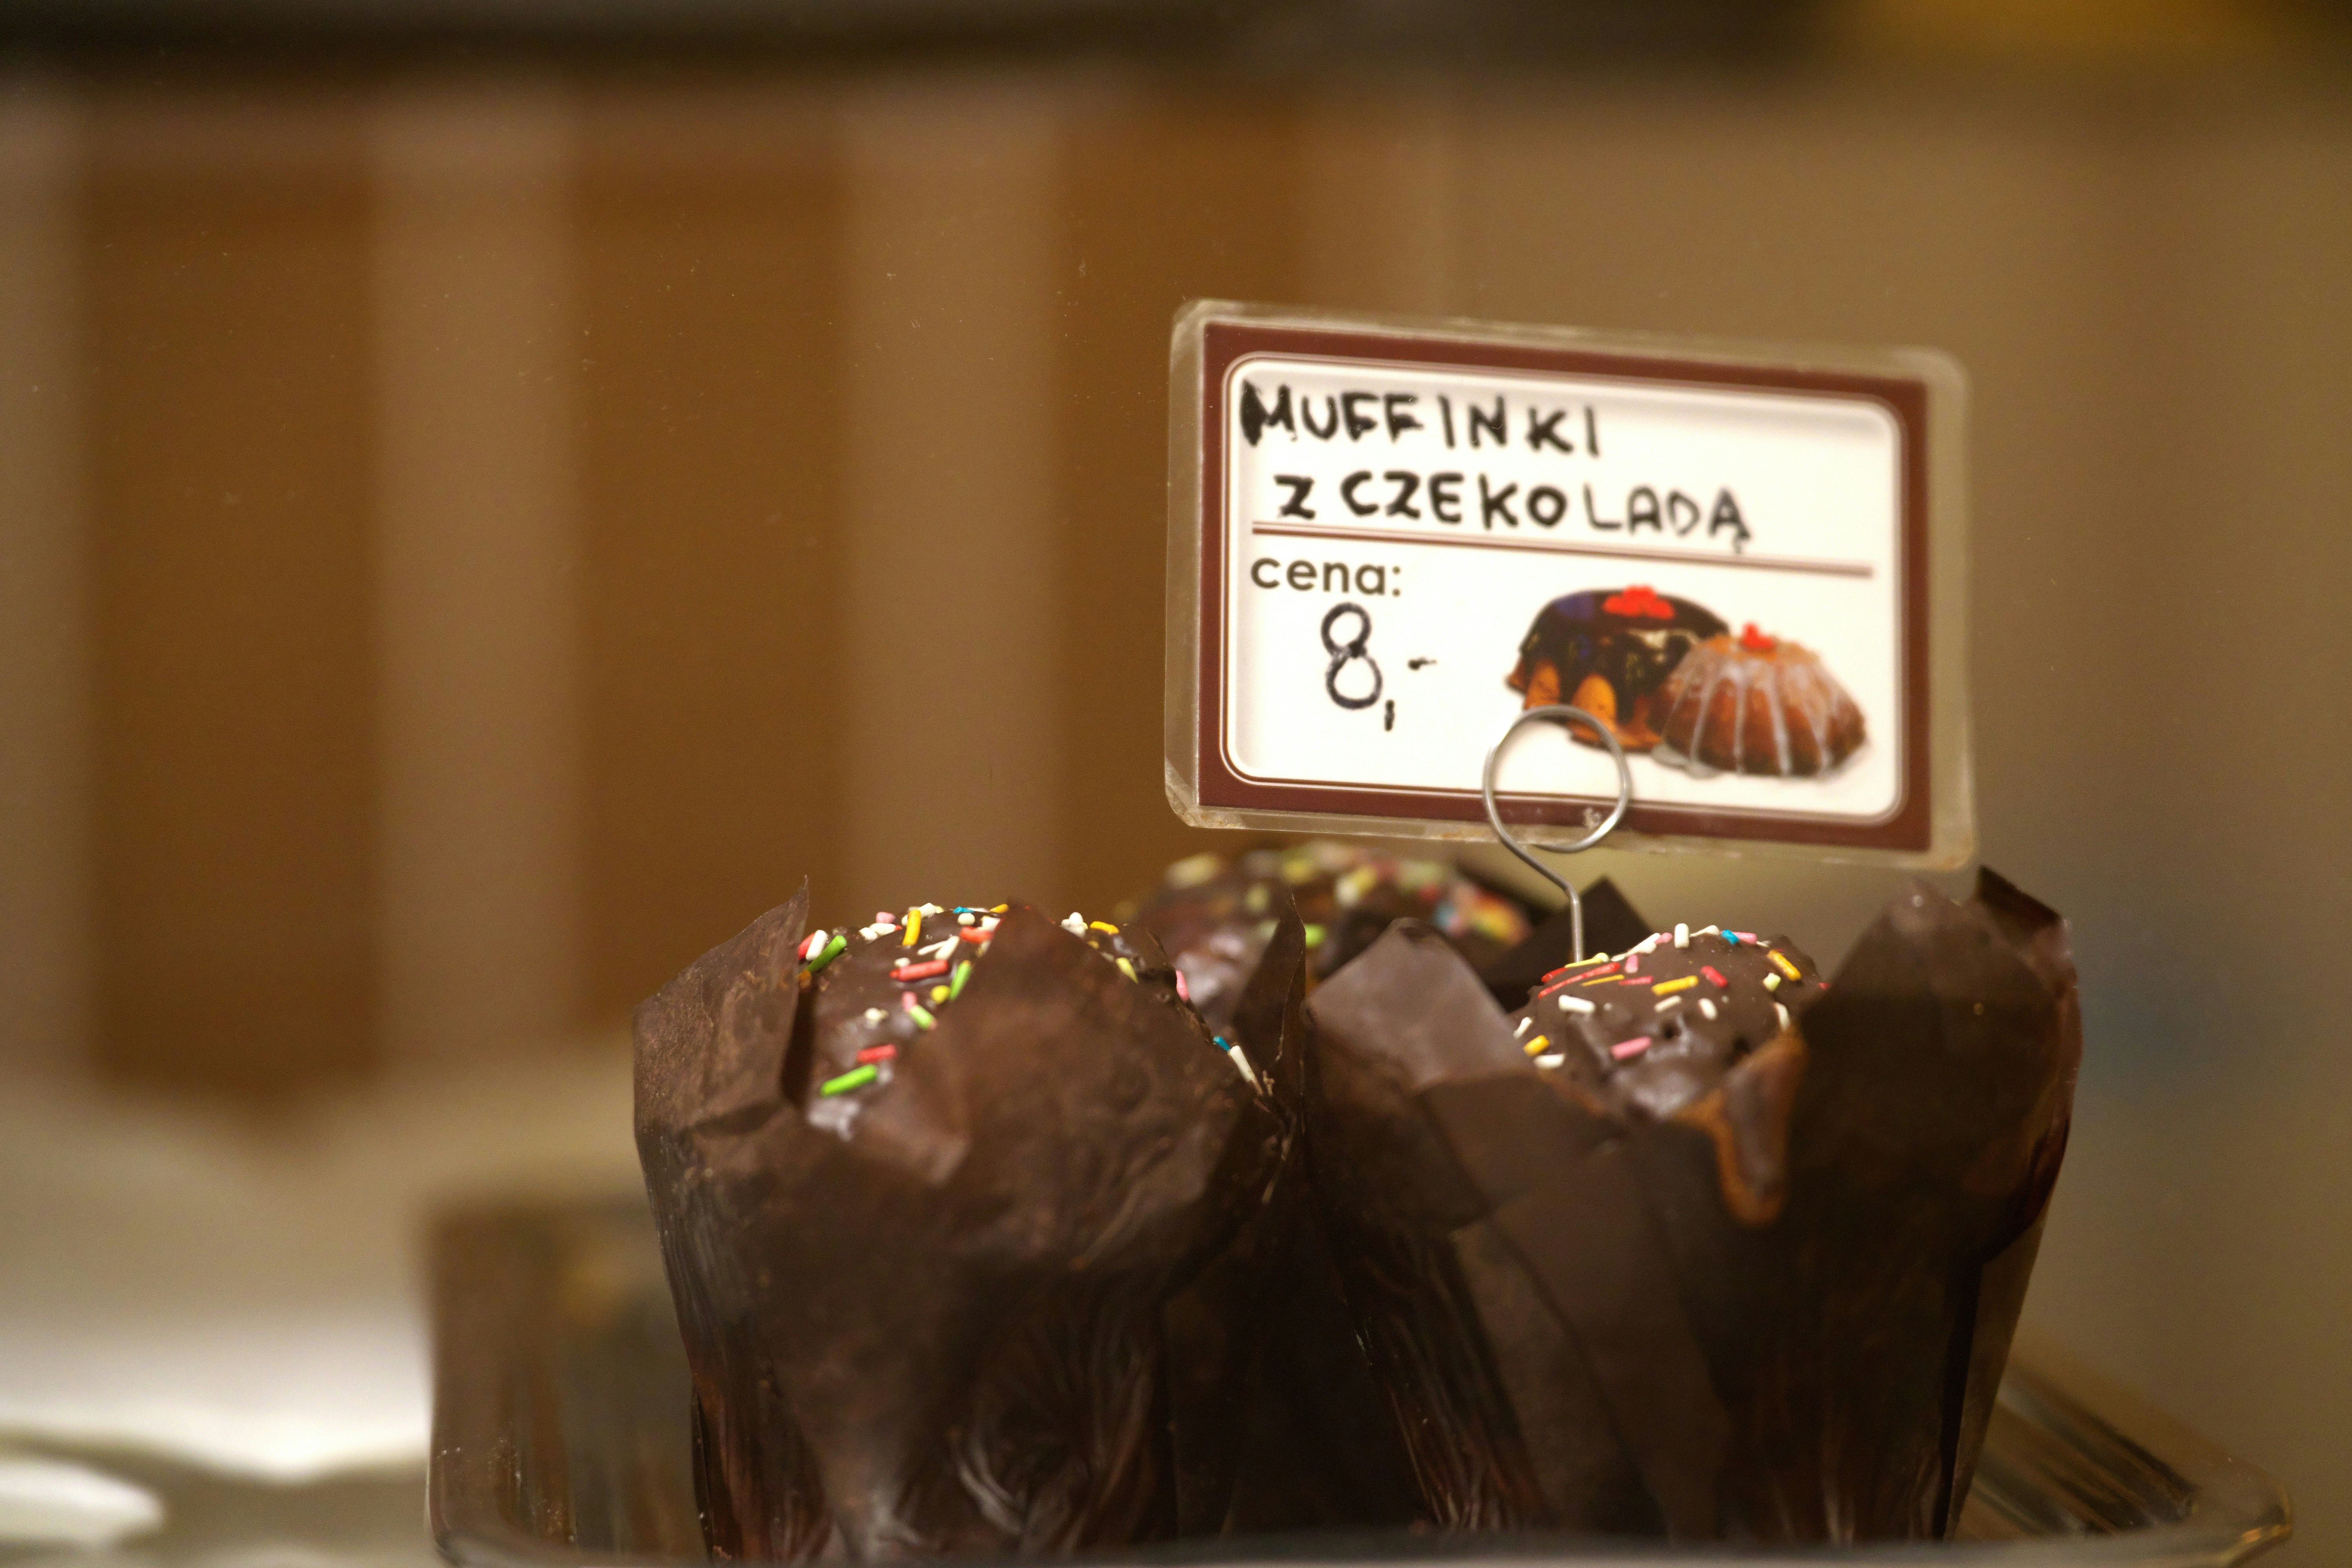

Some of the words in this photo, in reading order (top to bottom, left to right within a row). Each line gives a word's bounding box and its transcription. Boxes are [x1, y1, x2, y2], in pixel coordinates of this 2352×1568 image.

[1240, 379, 1599, 457] MUFFINKI
[1340, 470, 1751, 554] CZEKOLADĄ
[1250, 557, 1401, 597] cena:
